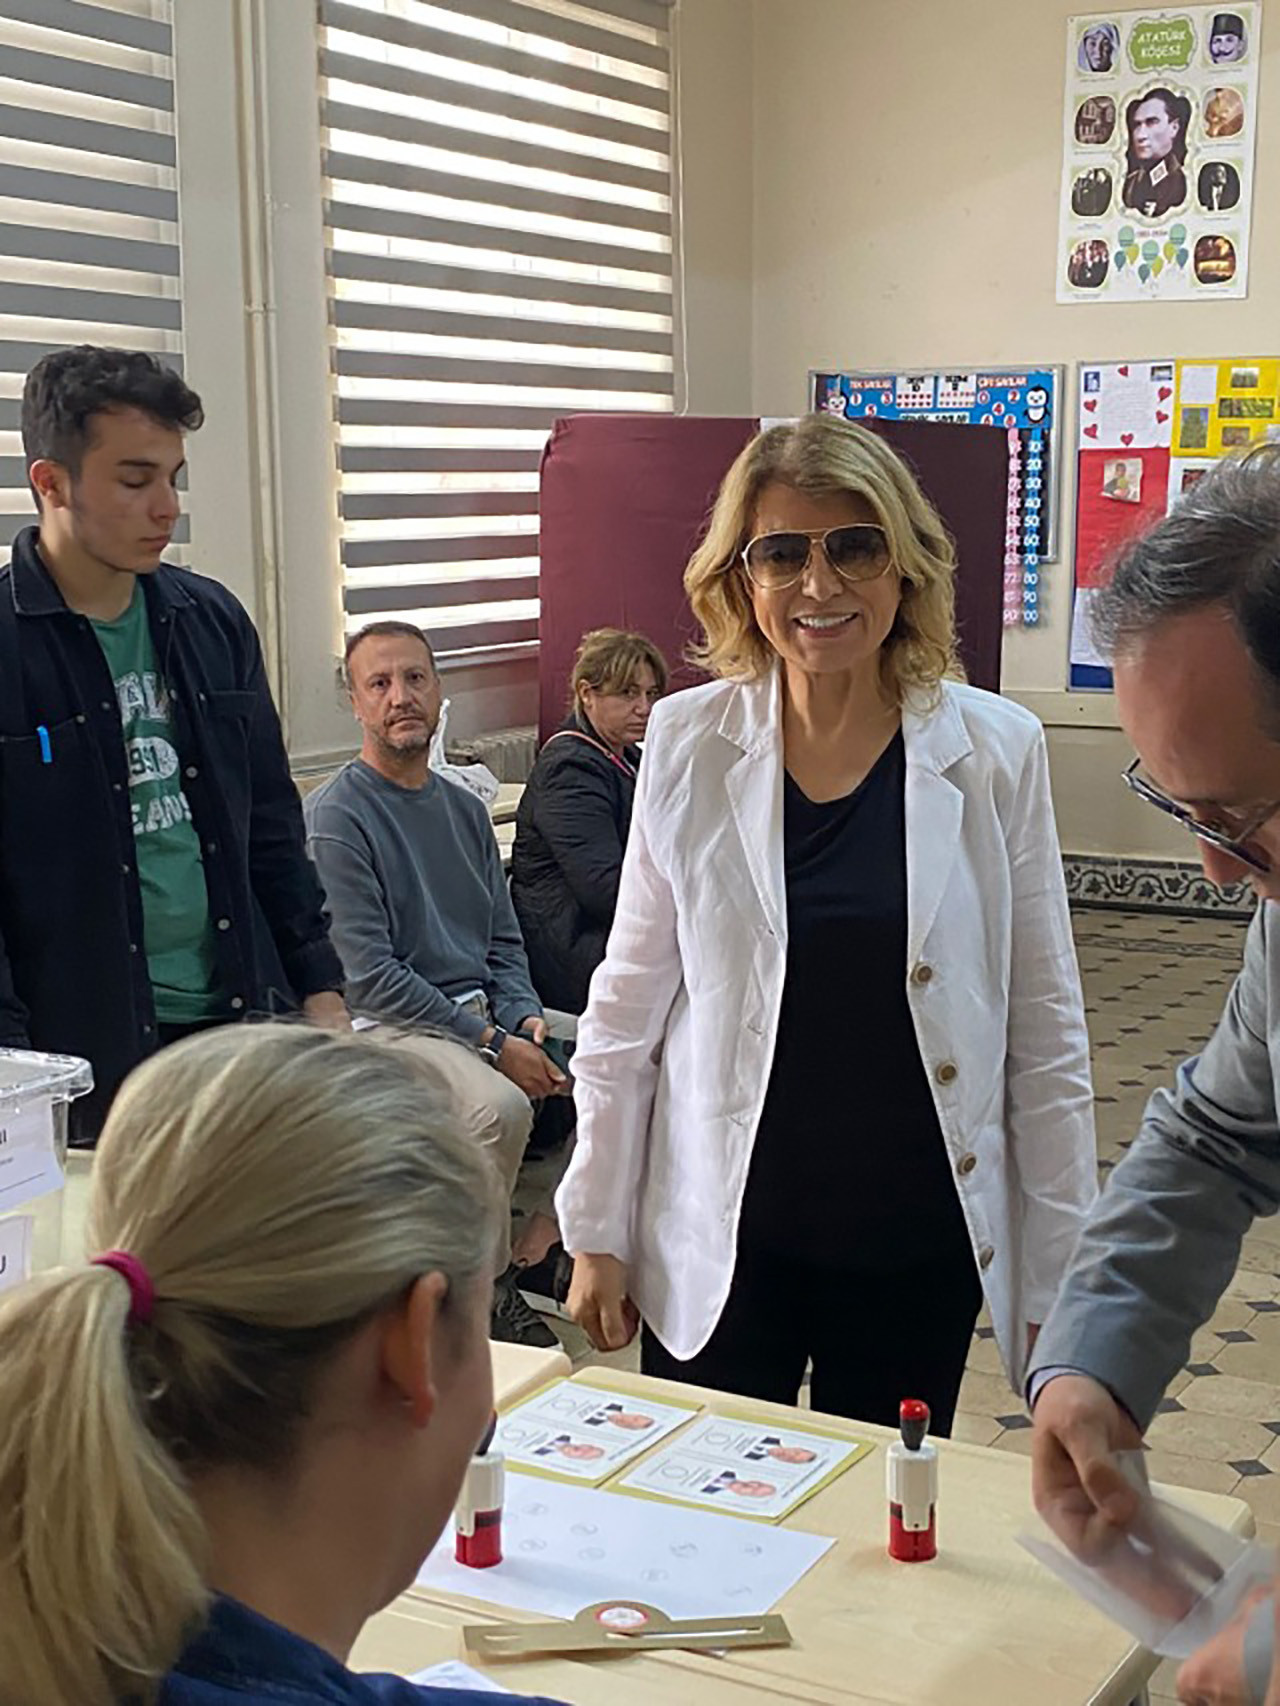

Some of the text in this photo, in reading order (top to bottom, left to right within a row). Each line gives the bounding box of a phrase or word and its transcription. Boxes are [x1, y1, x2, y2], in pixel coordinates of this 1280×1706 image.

[1009, 391, 1018, 402] 2
[993, 403, 1003, 414] 4
[1027, 458, 1042, 471] 20
[1023, 515, 1040, 528] 50
[1023, 534, 1040, 547] 60
[1023, 590, 1038, 603] 90
